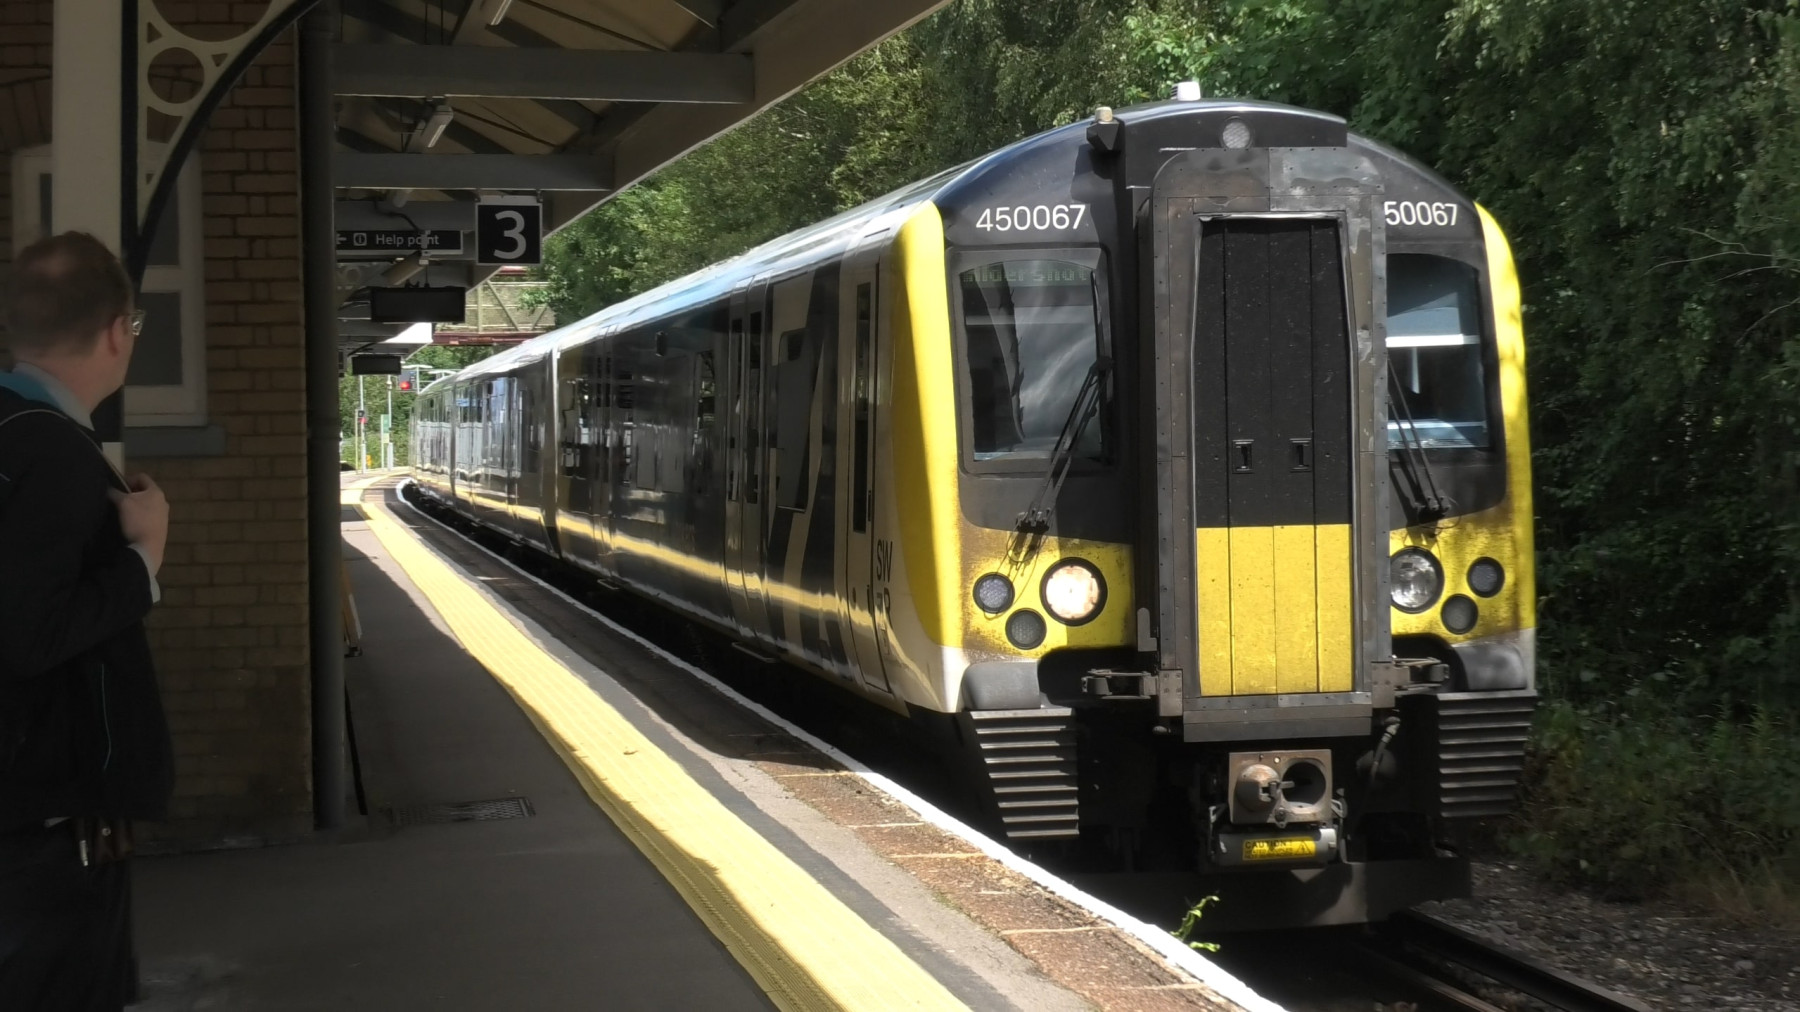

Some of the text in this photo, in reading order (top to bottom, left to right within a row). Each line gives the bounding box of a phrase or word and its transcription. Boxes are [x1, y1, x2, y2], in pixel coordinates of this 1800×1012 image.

[975, 204, 1086, 232] 450067
[1384, 201, 1458, 226] 50067
[376, 233, 439, 247] Help pont
[493, 210, 527, 260] 3
